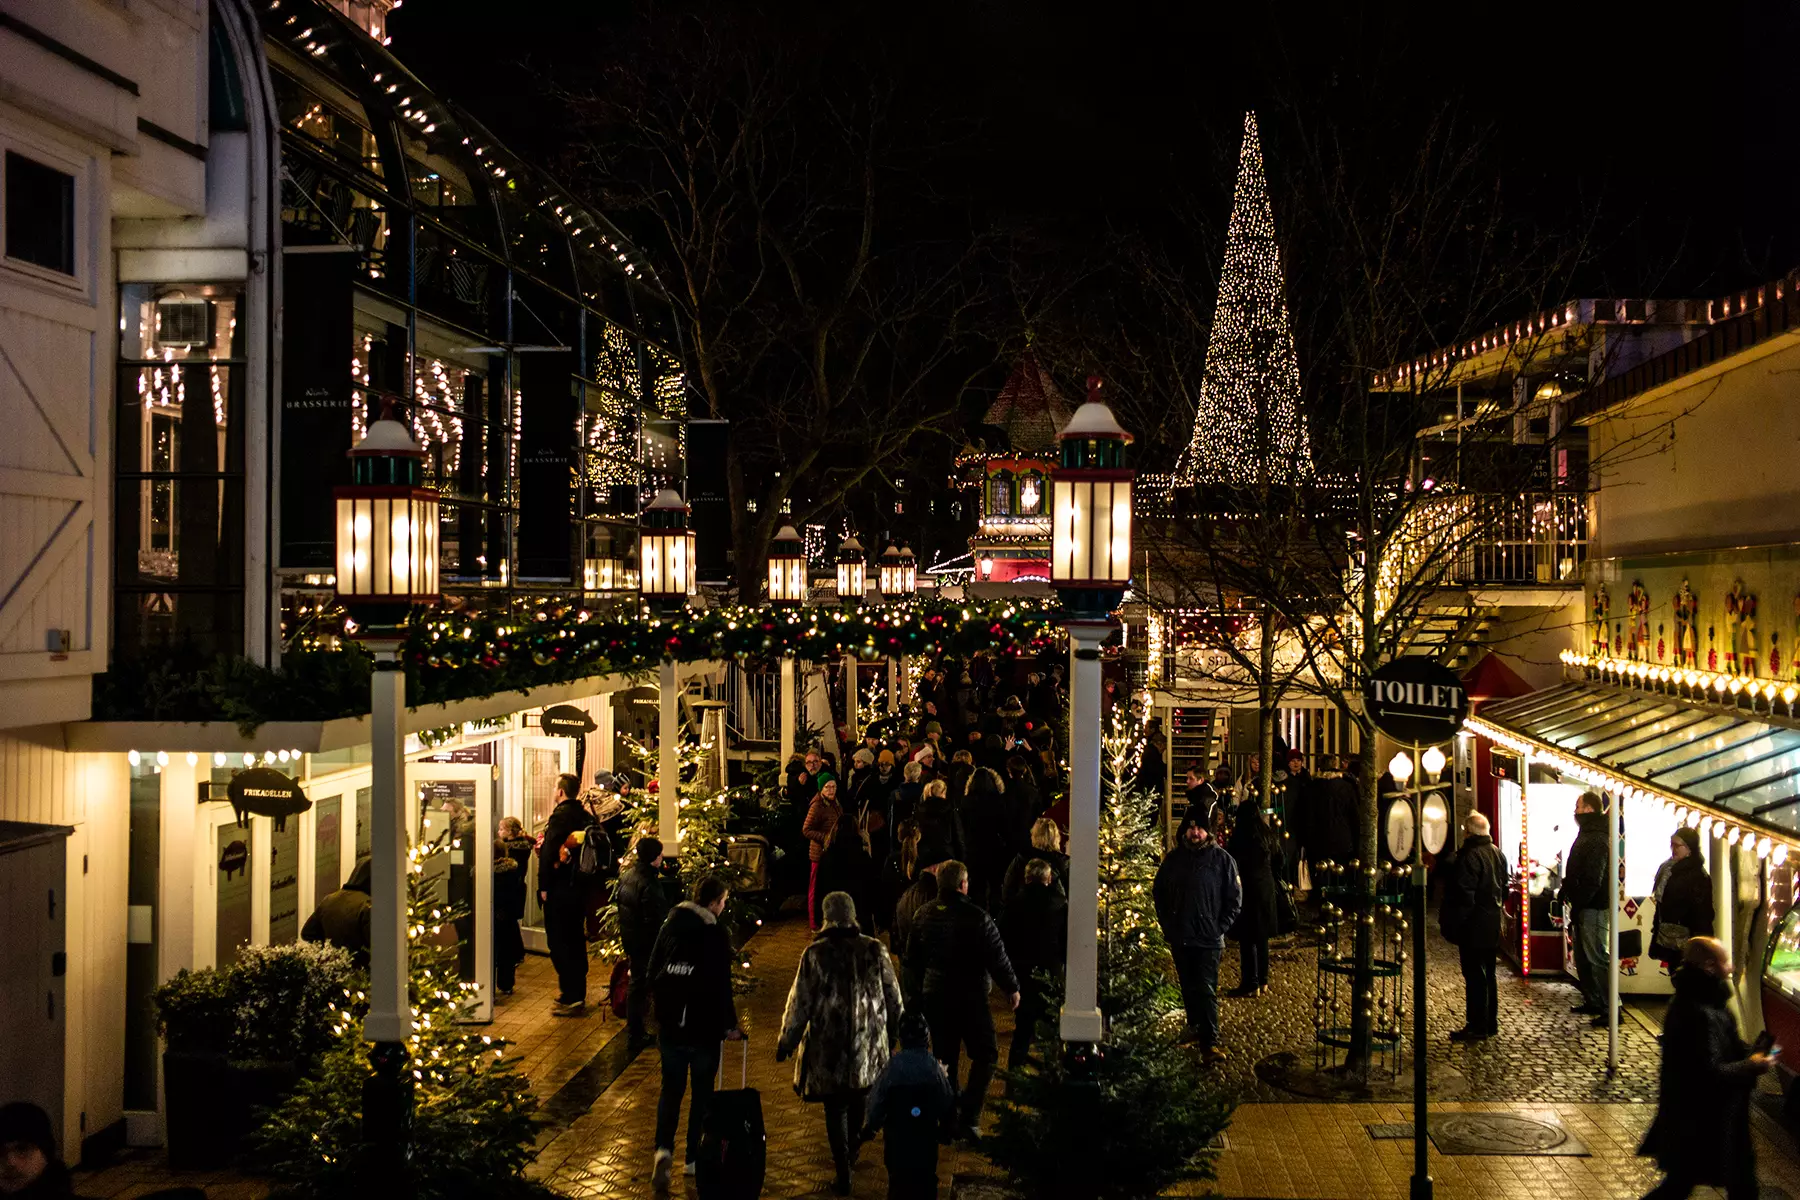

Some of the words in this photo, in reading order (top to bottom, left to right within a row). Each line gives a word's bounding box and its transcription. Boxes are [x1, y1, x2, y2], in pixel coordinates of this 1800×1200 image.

[286, 400, 349, 409] BRASSERIE
[1370, 679, 1463, 709] TOILET
[551, 718, 585, 727] FRIKADELLEN
[243, 788, 292, 798] FRIKADELLEN
